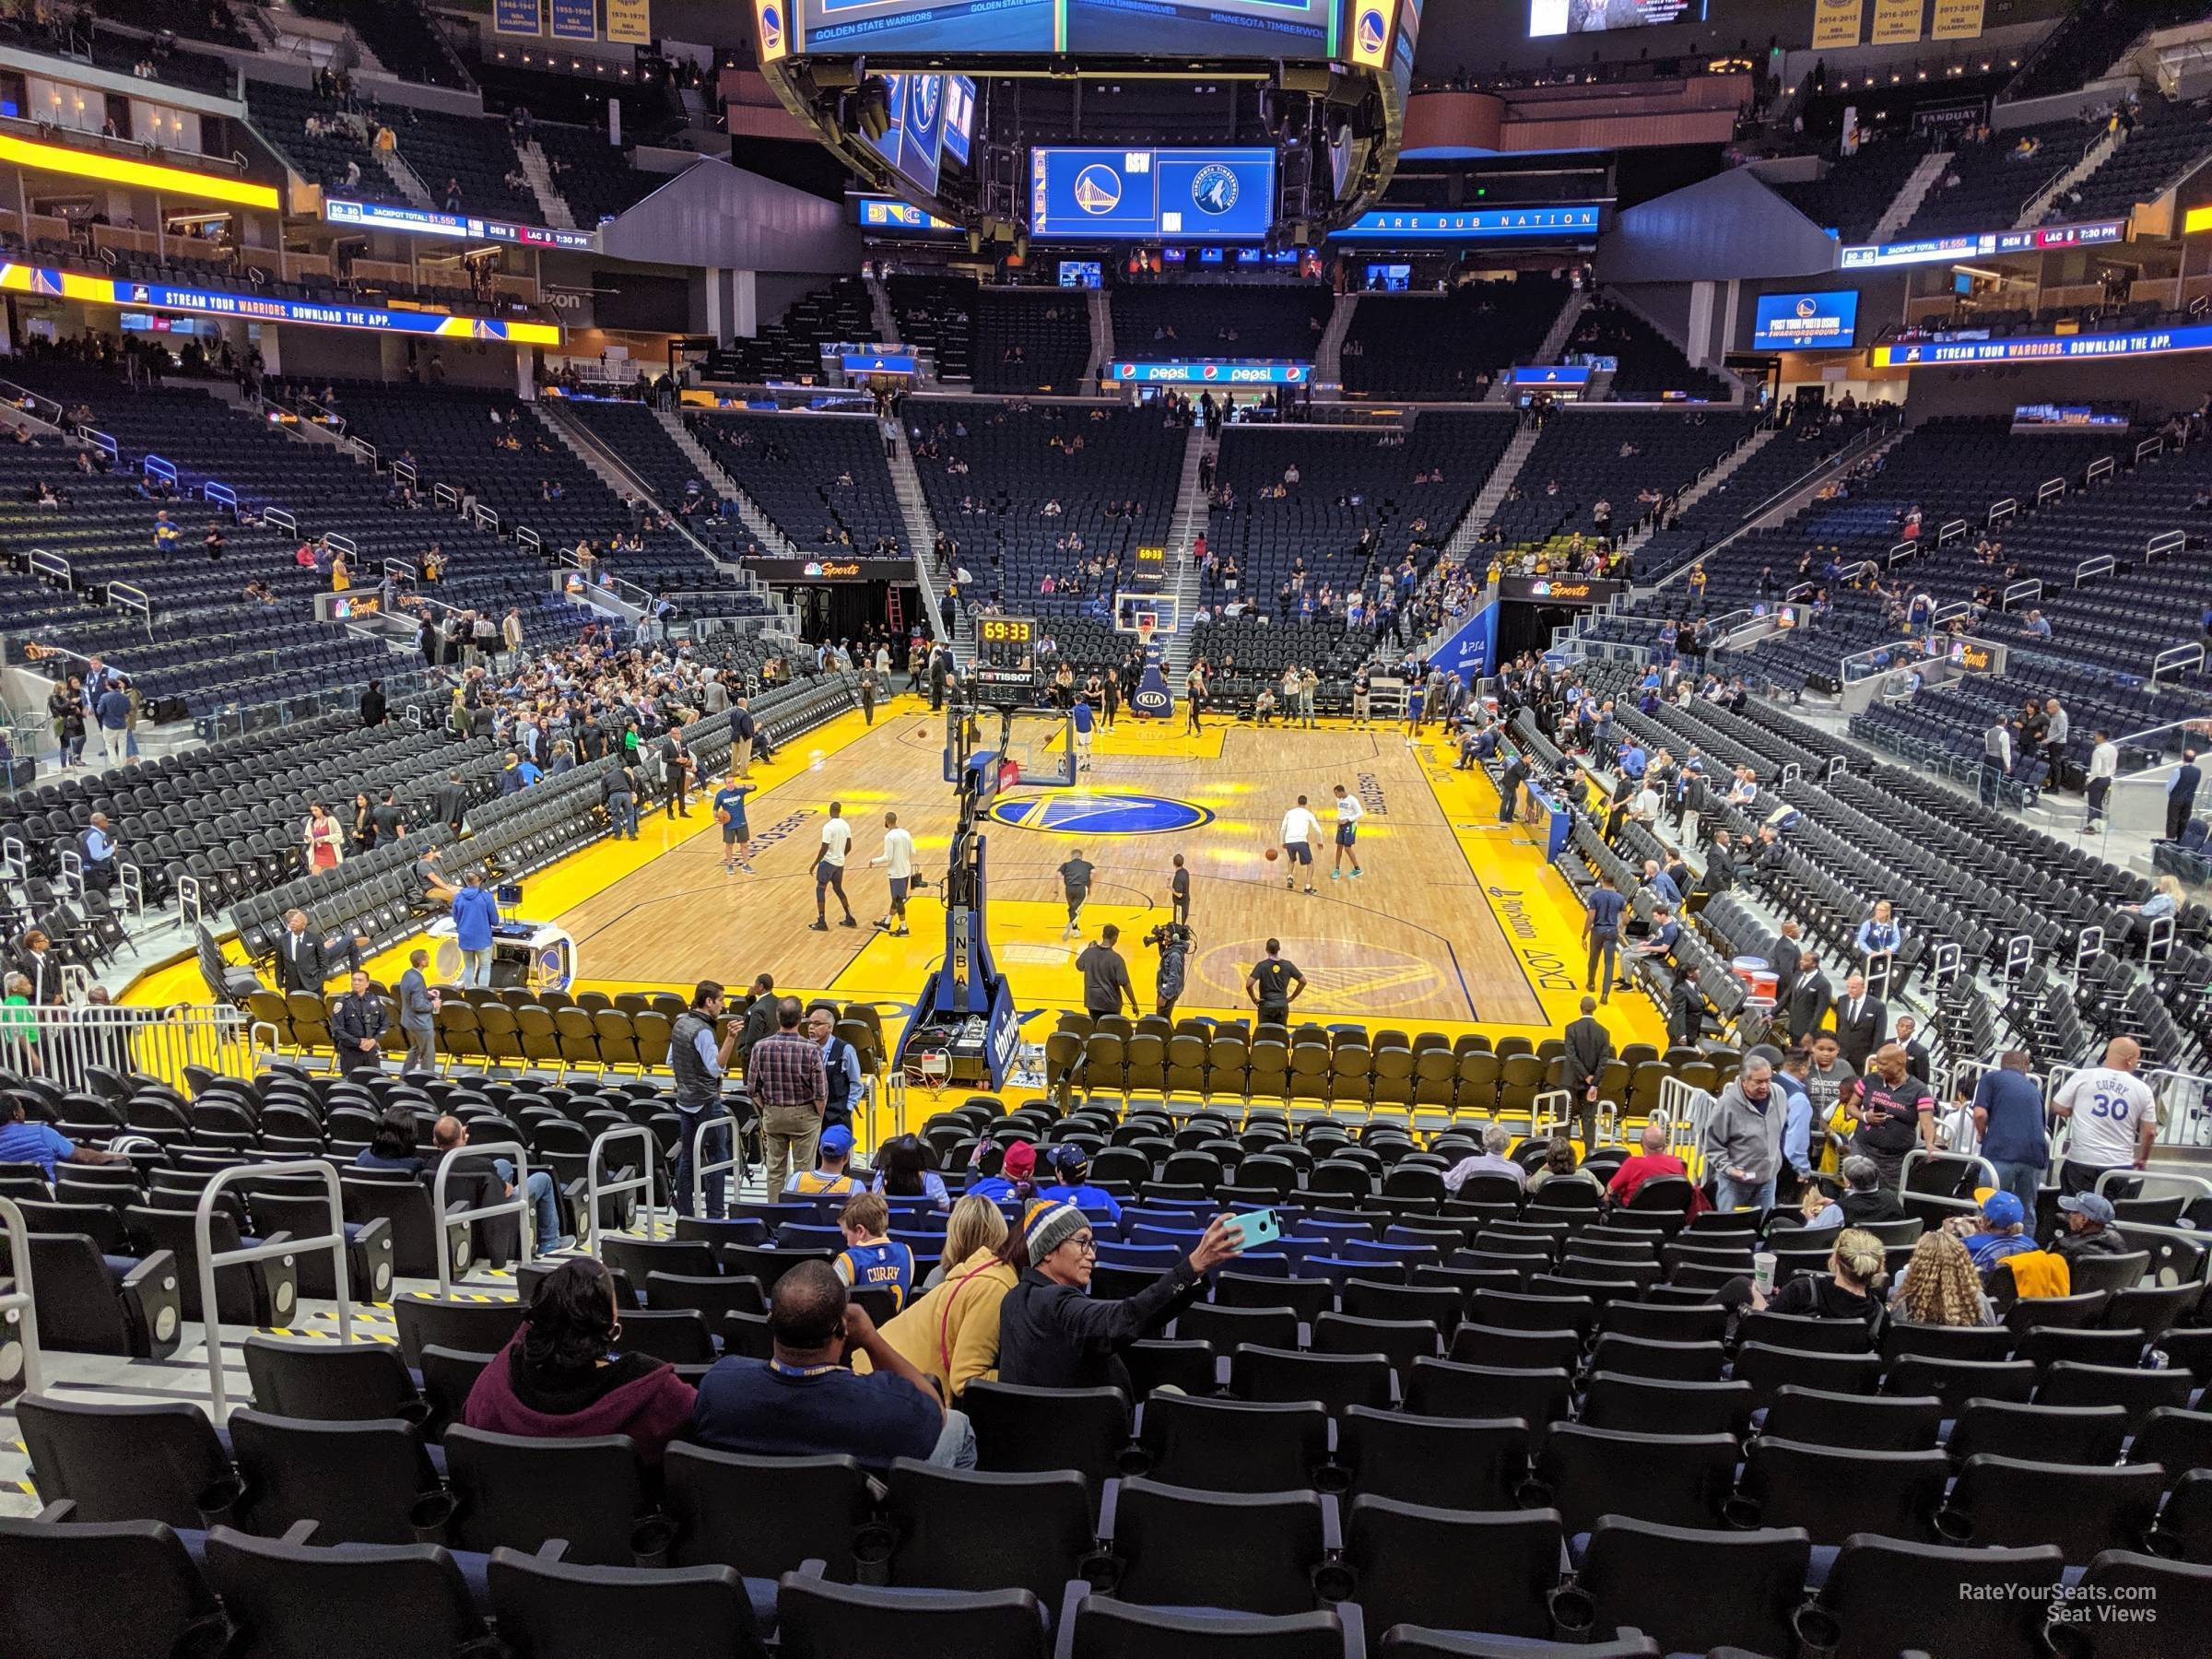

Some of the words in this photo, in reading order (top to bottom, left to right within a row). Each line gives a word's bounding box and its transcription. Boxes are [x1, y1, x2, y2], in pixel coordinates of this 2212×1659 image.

[971, 2, 1001, 13] GOLDEN
[1878, 9, 1918, 19] 2016-2017
[816, 24, 855, 41] GOLDEN
[856, 19, 885, 34] STATE
[886, 11, 933, 29] WARRIORS
[1210, 12, 1265, 29] MINNESOTA
[1818, 14, 1857, 24] 2014-2015
[1937, 24, 1978, 32] CHAMPIONS
[1921, 111, 1978, 124] TANDUAY
[373, 208, 405, 219] JACKPOT
[405, 211, 429, 222] TOTAL:
[1378, 218, 1418, 229] ARE
[1439, 217, 1480, 229] DUB
[1500, 213, 1591, 227] NATION
[490, 226, 506, 236] DEN
[526, 230, 542, 241] LAC
[556, 235, 573, 244] 7:30
[574, 237, 587, 246] PM
[2044, 232, 2063, 242] LAC
[2079, 229, 2099, 239] 7:30
[2101, 227, 2117, 238] PM
[1888, 243, 1916, 255] JACKPOT
[1916, 241, 1938, 252] TOTAL:
[2002, 236, 2021, 247] DEN
[166, 292, 206, 307] STREAM
[209, 297, 235, 311] YOUR
[238, 300, 289, 317] WARRIORS.
[292, 306, 341, 323] DOWNLOAD
[346, 312, 365, 324] THE
[369, 313, 391, 326] APP.
[1936, 347, 1974, 360] STREAM
[1979, 346, 2005, 359] YOUR
[2008, 342, 2066, 357] WARRIORS.
[2070, 338, 2126, 354] DOWNLOAD
[2130, 337, 2147, 351] THE
[2150, 335, 2171, 348] APP.
[1149, 368, 1188, 381] pepsi
[1231, 369, 1272, 382] pepsi
[1139, 549, 1162, 559] 69:33
[820, 562, 860, 578] Sports
[1549, 582, 1590, 597] Sports
[348, 597, 379, 619] Sports
[985, 622, 1029, 641] 69:33
[1468, 641, 1484, 653] PS4
[1961, 644, 1988, 670] Sports
[994, 673, 1032, 681] TISSOT
[1141, 694, 1162, 704] KIA
[994, 1010, 1019, 1065] thrive
[2096, 1080, 2130, 1095] CURRY
[2090, 1094, 2129, 1121] 30
[866, 1265, 900, 1283] CURRY
